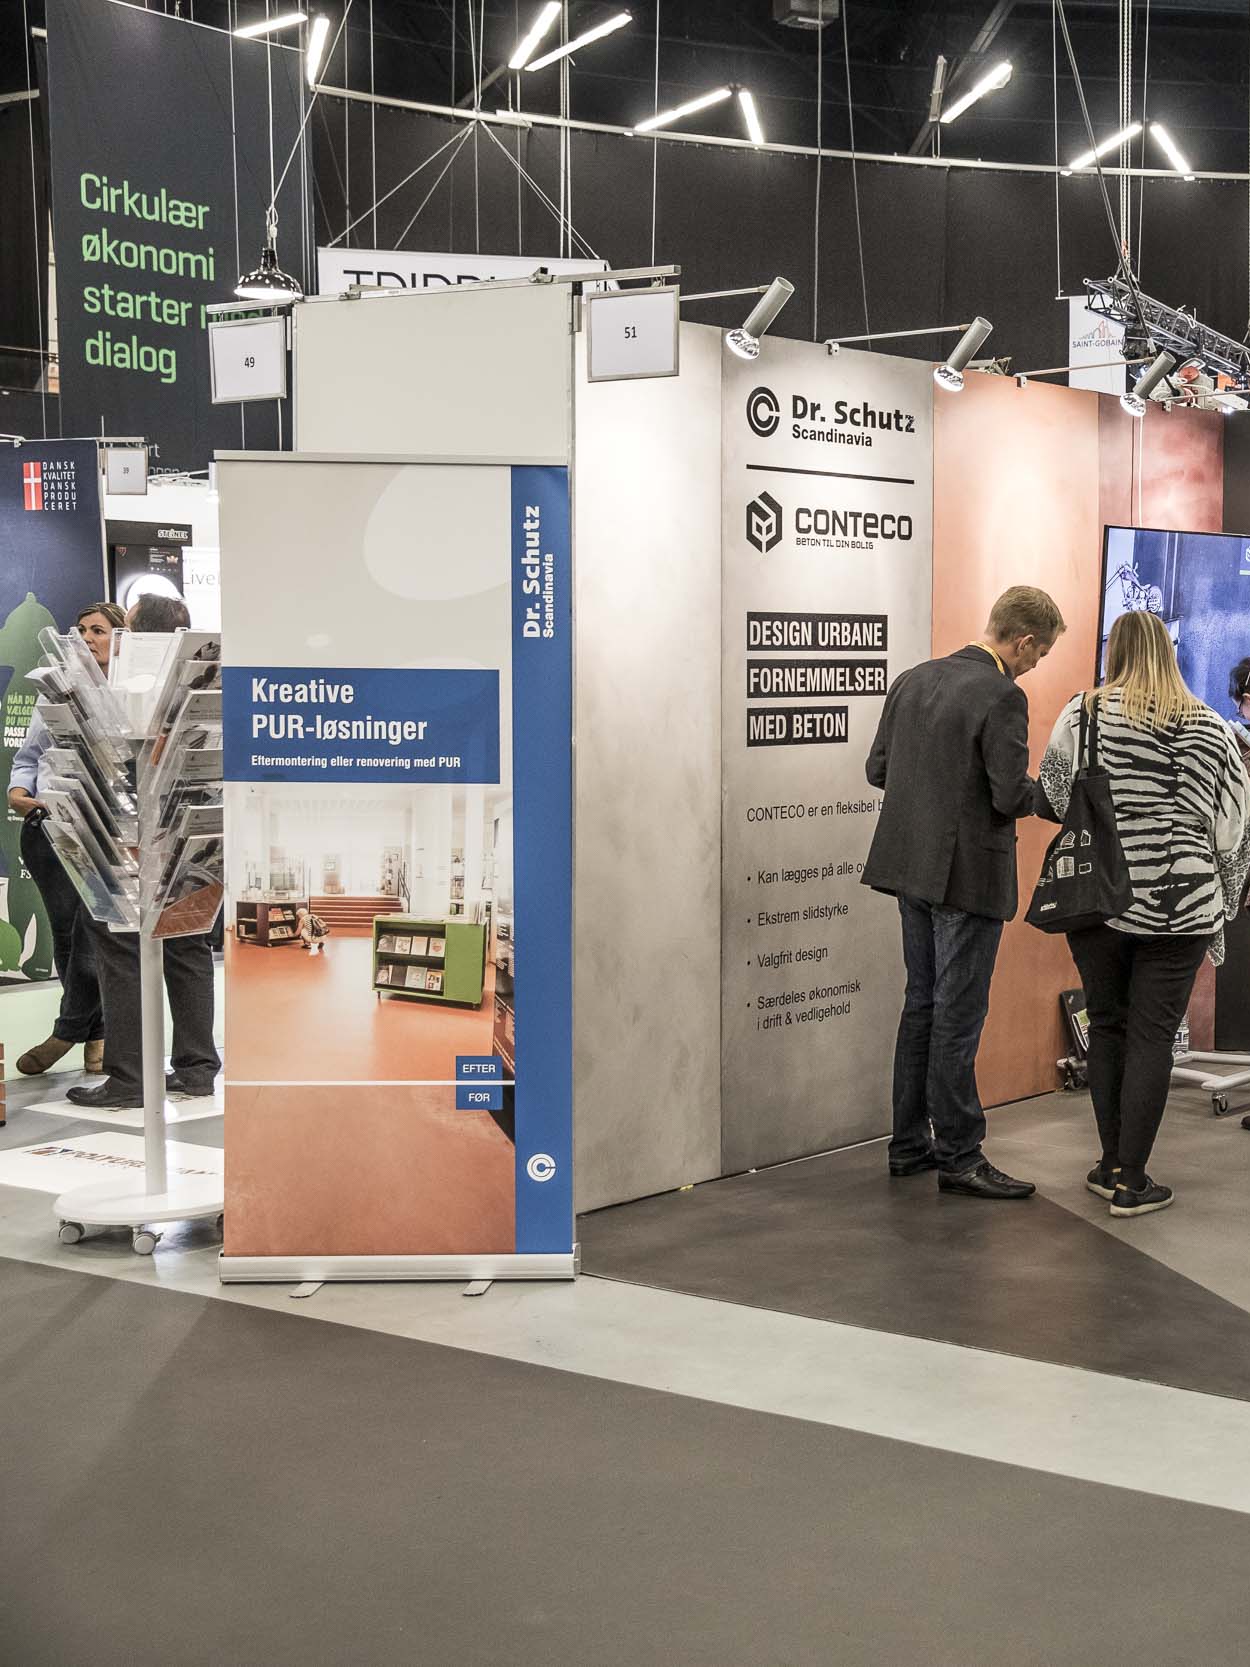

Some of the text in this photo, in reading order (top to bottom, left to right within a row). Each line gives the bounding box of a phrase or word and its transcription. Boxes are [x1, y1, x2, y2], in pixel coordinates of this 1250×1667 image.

[80, 173, 210, 230] Cirkulær
[81, 228, 215, 281] økonomi
[83, 284, 192, 326] starter
[624, 326, 637, 339] 51
[85, 330, 177, 383] dialog
[244, 357, 255, 368] 49
[792, 394, 915, 433] Dr. Schutz
[792, 424, 872, 447] Scandinavia
[43, 461, 75, 470] DANSK
[43, 471, 75, 480] KVALITET
[43, 481, 76, 491] DANSK
[44, 491, 77, 501] PRODU
[44, 501, 77, 511] CERET
[822, 538, 834, 547] TIL
[836, 540, 849, 549] DIN
[851, 540, 874, 550] BOLIG
[521, 506, 541, 638] Dr. Schutz
[542, 553, 554, 638] Scandinavia
[750, 620, 883, 647] DESIGN URBANE
[252, 678, 354, 704] Kreative
[750, 667, 885, 693] FORNEMMELSER
[4, 727, 25, 736] PASSE
[6, 716, 16, 726] DU
[252, 714, 428, 746] PUR-løsninger
[750, 713, 846, 740] MED BETON
[251, 755, 461, 769] Eftermontering eller renovering med PUR
[747, 804, 805, 822] CONTECO
[808, 806, 818, 817] er
[821, 805, 833, 817] en
[836, 799, 875, 816] fleksibel
[758, 870, 778, 884] Kan
[782, 867, 819, 884] lægges
[821, 863, 834, 880] på
[837, 861, 854, 875] alle
[758, 902, 848, 926] Ekstrem slidstyrke
[757, 946, 828, 968] Valgfrit design
[757, 979, 861, 1010] Særdeles økonomisk
[763, 1012, 782, 1030] drift
[784, 1011, 793, 1025] &
[796, 1001, 851, 1022] vedligehold
[462, 1064, 496, 1073] EFTER
[468, 1093, 490, 1102] FØR
